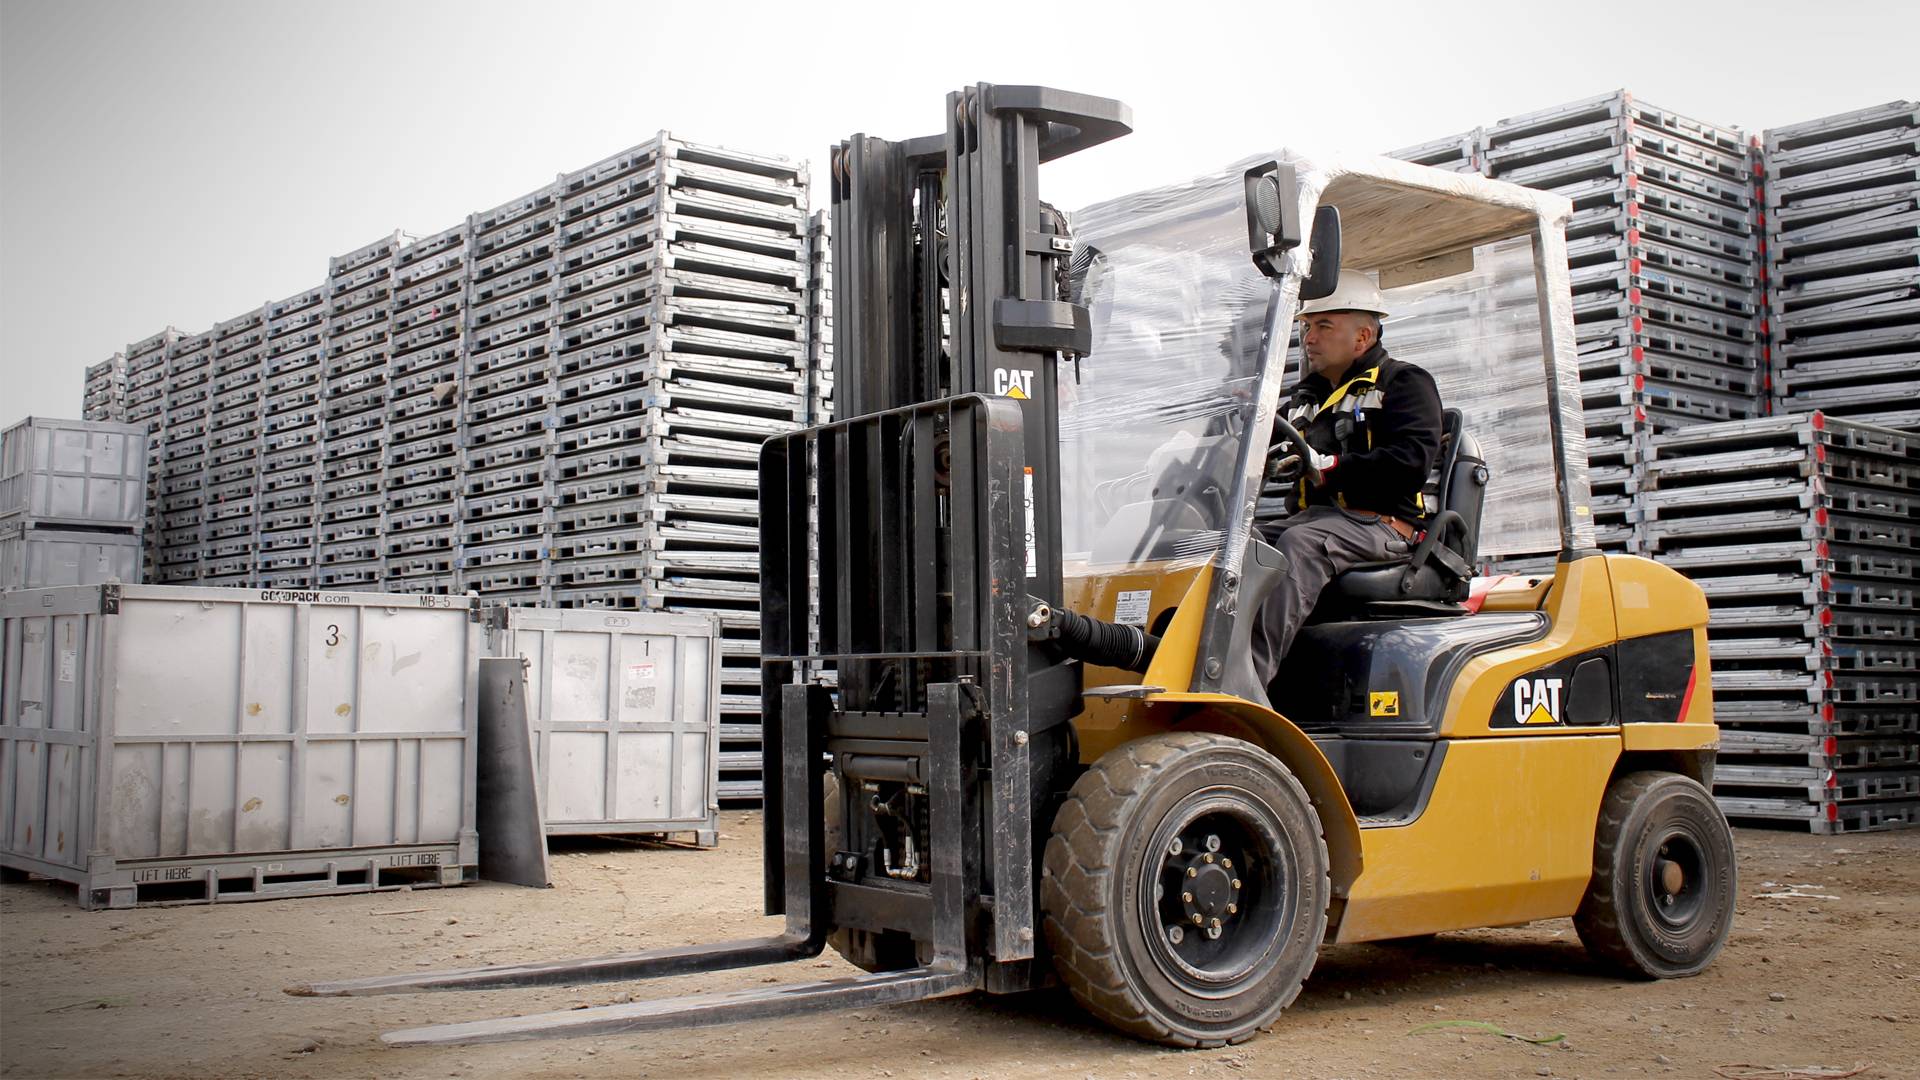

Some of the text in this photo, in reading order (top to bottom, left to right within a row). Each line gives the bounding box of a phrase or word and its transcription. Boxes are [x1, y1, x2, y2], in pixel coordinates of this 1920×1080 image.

[994, 368, 1034, 399] CAT
[420, 595, 450, 608] MB-5
[326, 624, 339, 647] 3
[644, 640, 649, 656] 1
[1514, 678, 1562, 724] CAT
[390, 853, 440, 866] LIFT HERE
[132, 867, 192, 882] LIFT HERE
